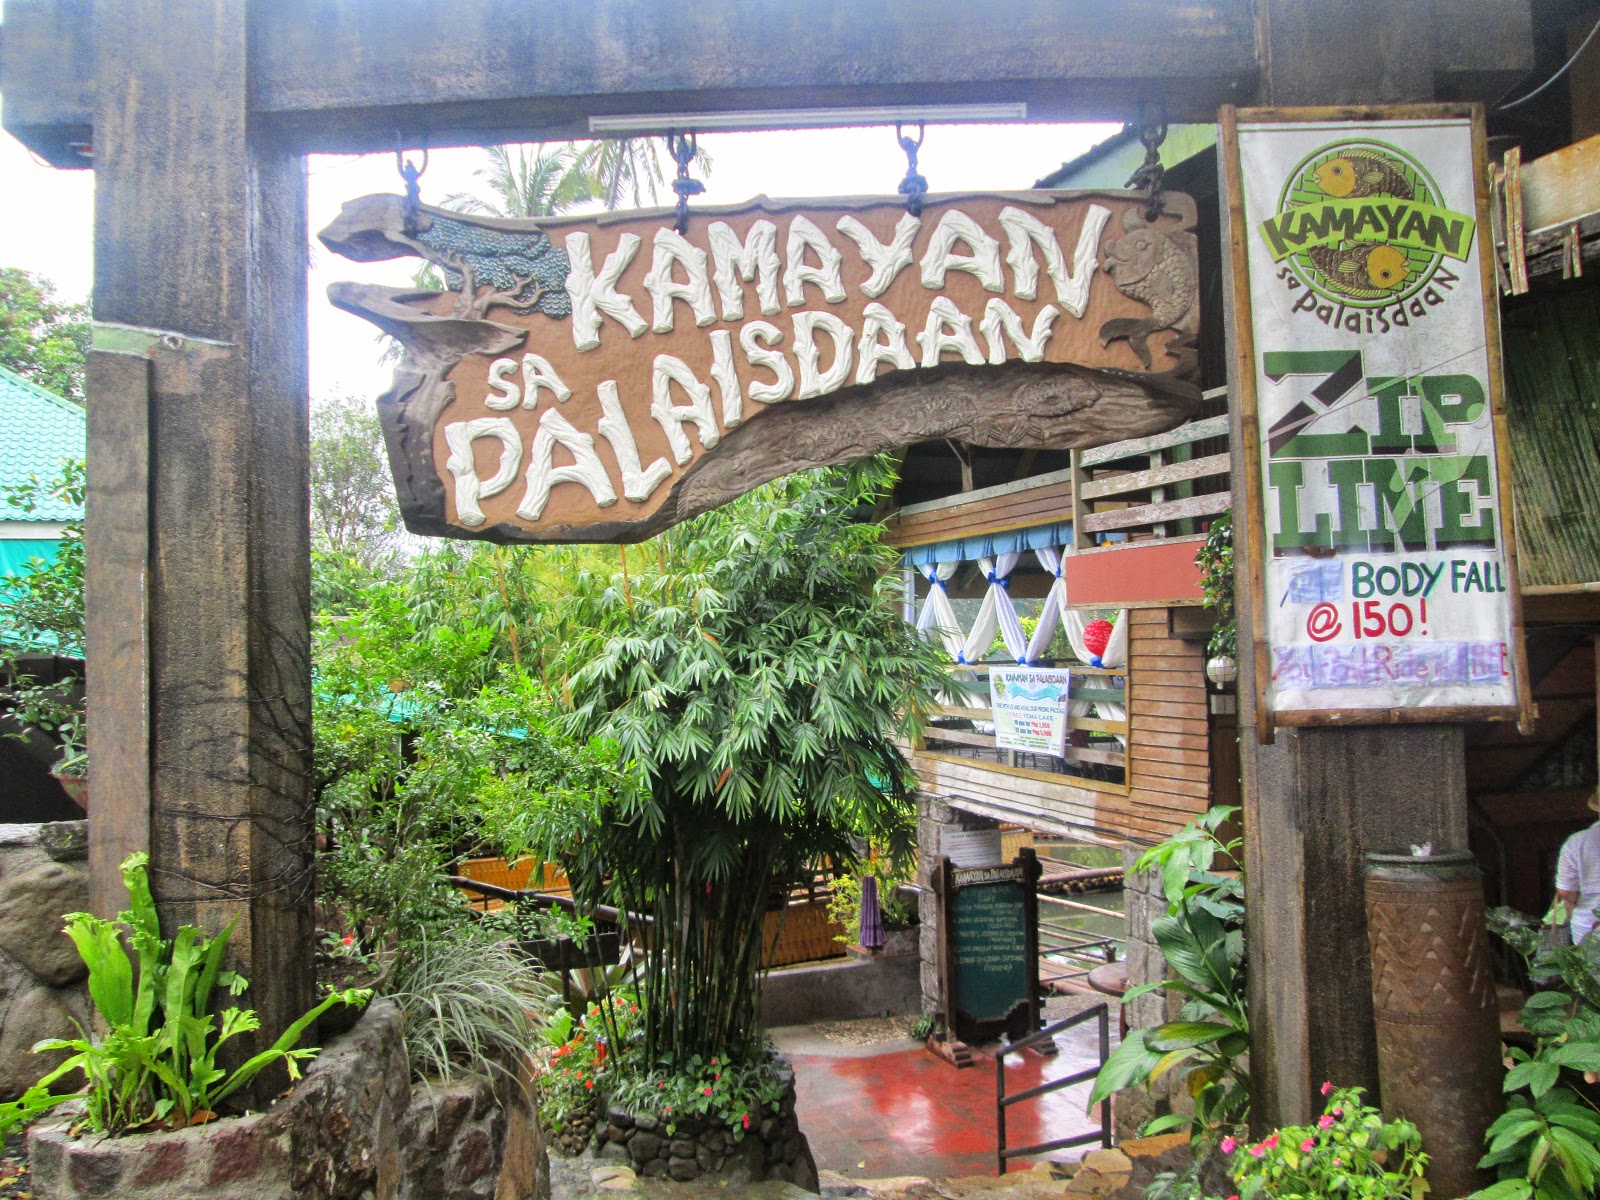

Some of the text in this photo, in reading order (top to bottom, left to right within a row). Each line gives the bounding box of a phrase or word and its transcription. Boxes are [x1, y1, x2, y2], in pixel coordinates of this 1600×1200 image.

[1263, 204, 1465, 256] KAMAYAN
[565, 203, 1112, 352] KAMAYAN
[1276, 266, 1301, 290] sa
[445, 295, 1060, 527] PALAISDAAN
[484, 353, 572, 411] SA
[1263, 349, 1486, 457] ZIP
[1268, 455, 1497, 557] LINE
[1352, 560, 1445, 598] BODY
[1451, 559, 1506, 593] FALL
